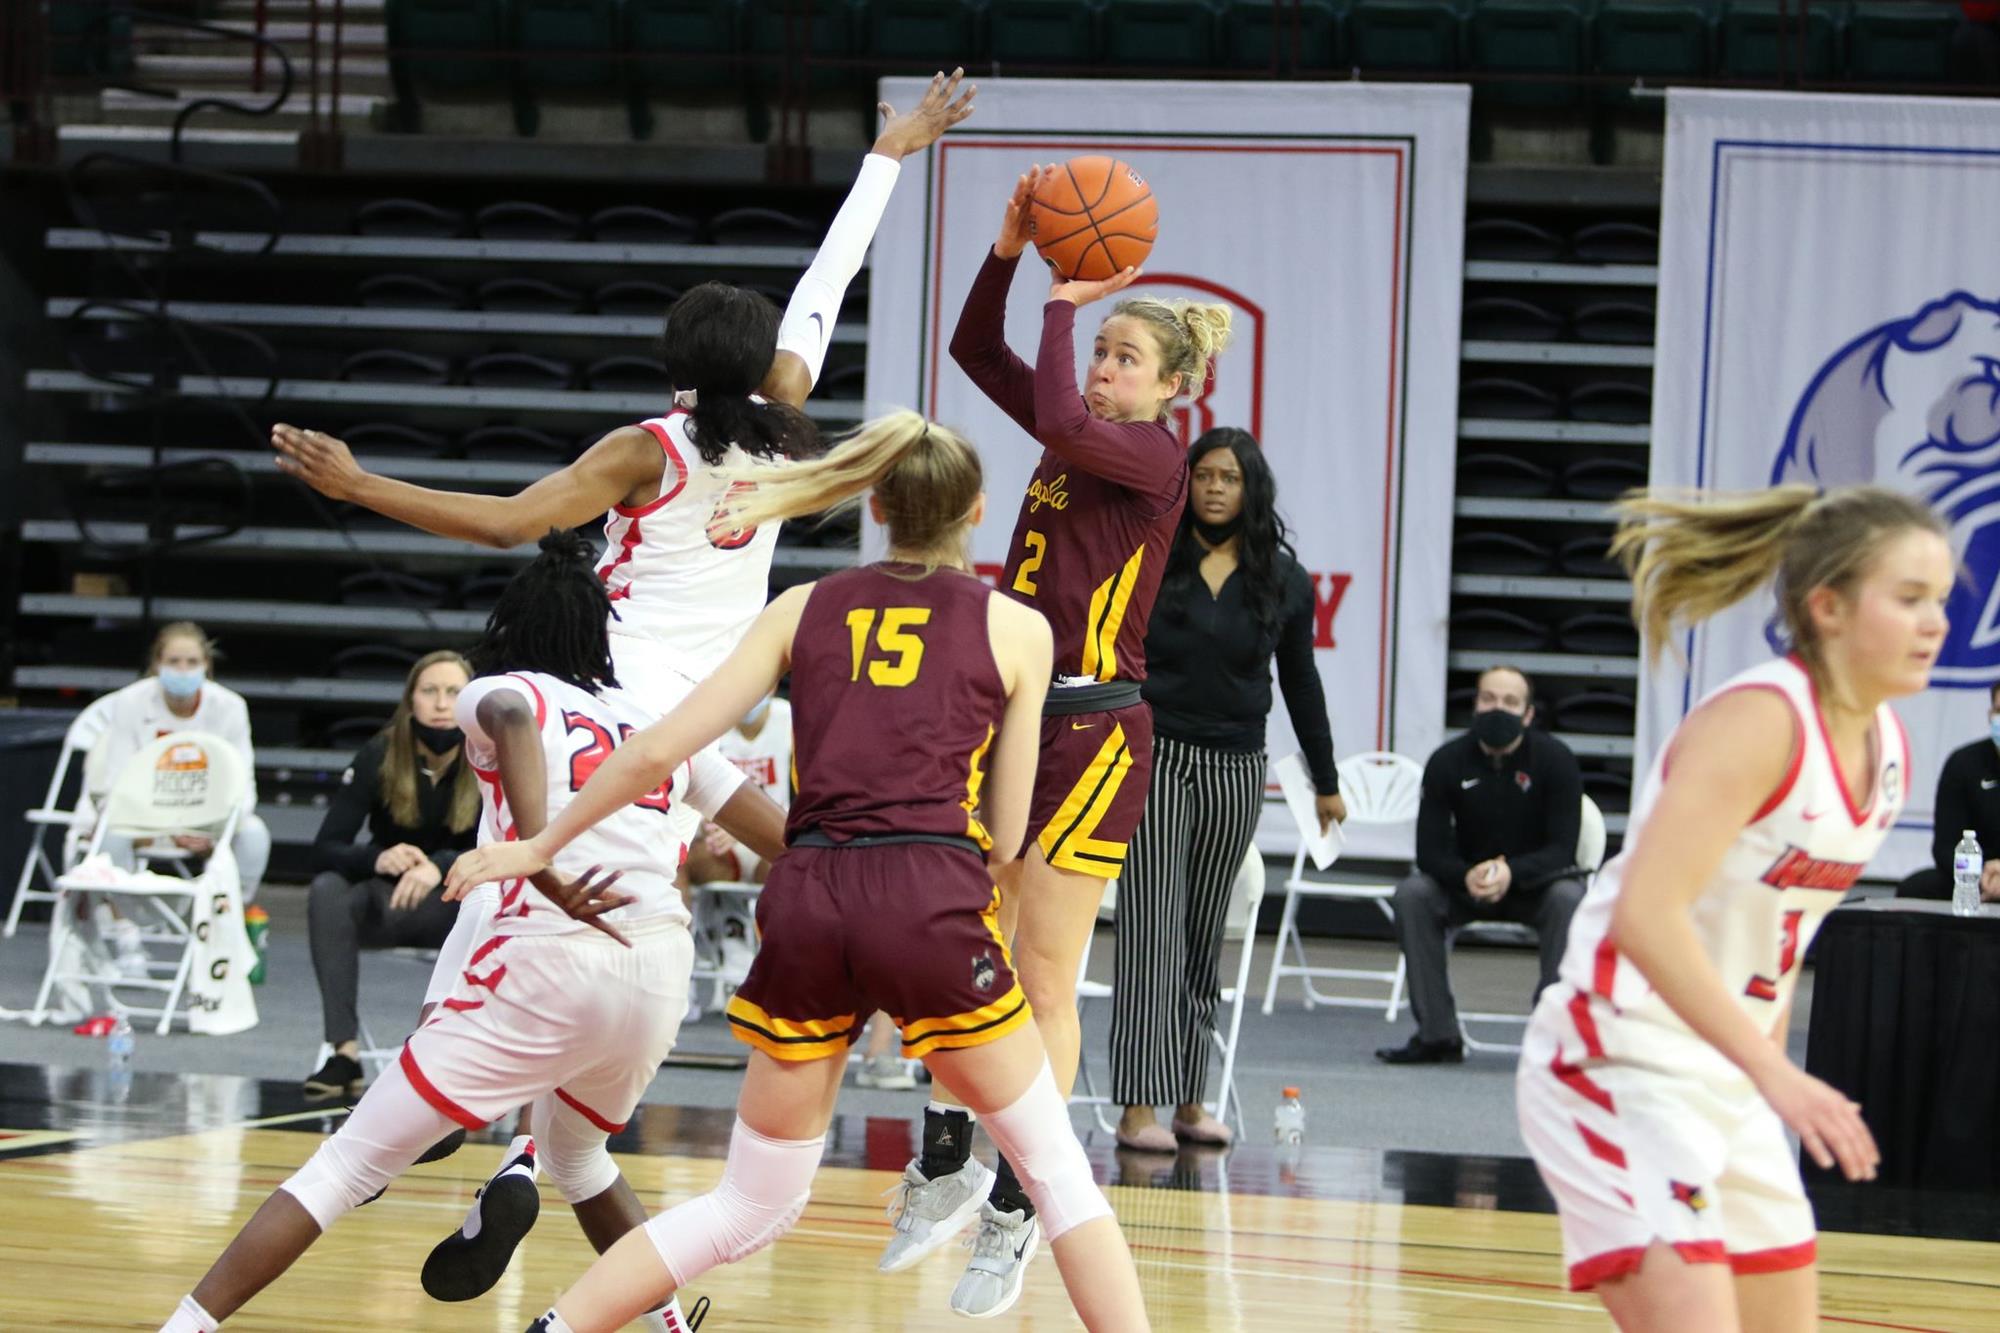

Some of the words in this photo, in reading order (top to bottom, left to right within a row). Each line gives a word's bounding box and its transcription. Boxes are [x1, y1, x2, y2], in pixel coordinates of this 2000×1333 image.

[1025, 473, 1070, 514] oyola
[1012, 529, 1047, 597] 2
[845, 606, 932, 687] 15
[560, 708, 674, 815] 2
